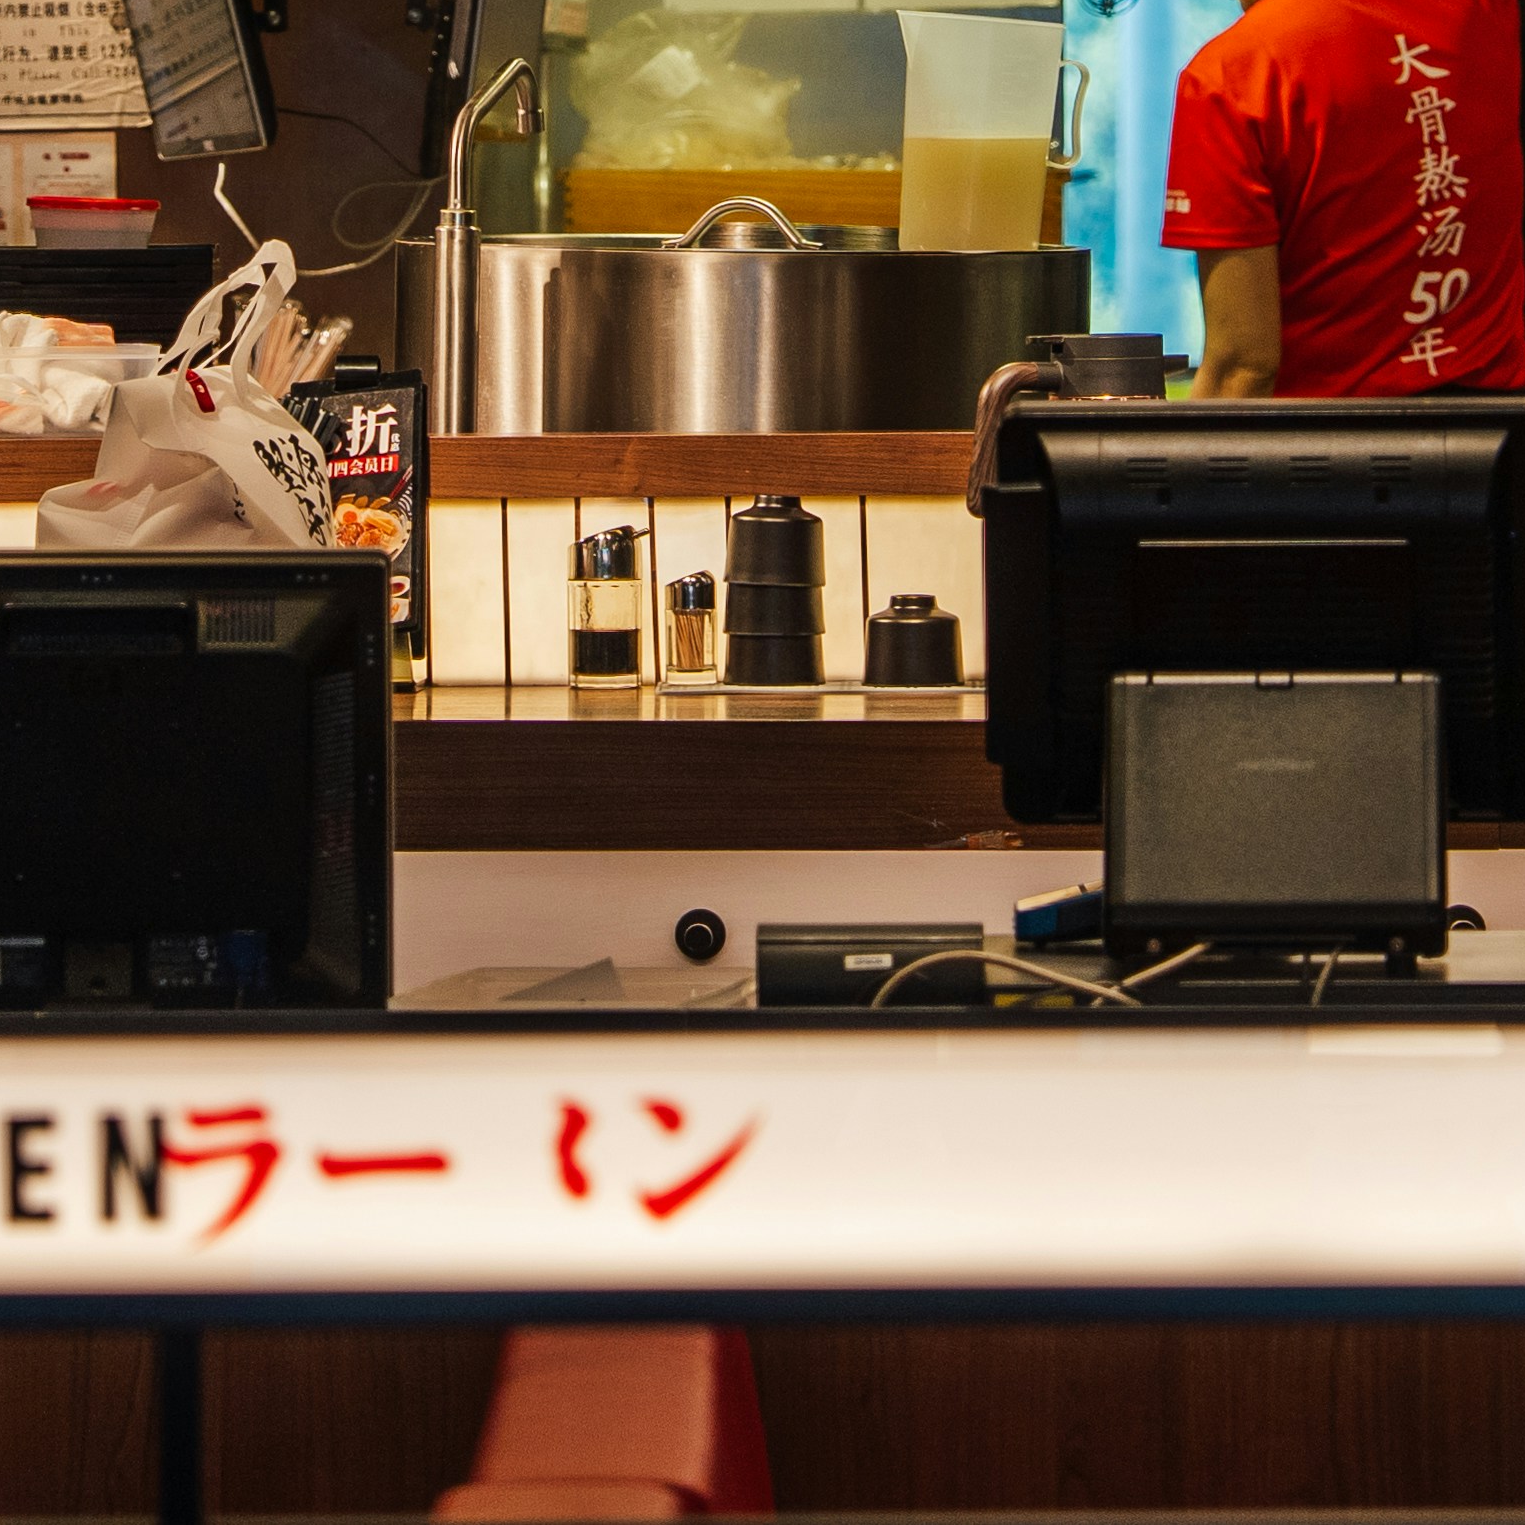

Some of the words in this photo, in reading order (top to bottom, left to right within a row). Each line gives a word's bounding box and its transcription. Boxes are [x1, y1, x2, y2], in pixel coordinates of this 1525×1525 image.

[1388, 32, 1470, 378] 大骨熬汤50年
[335, 403, 399, 456] 折
